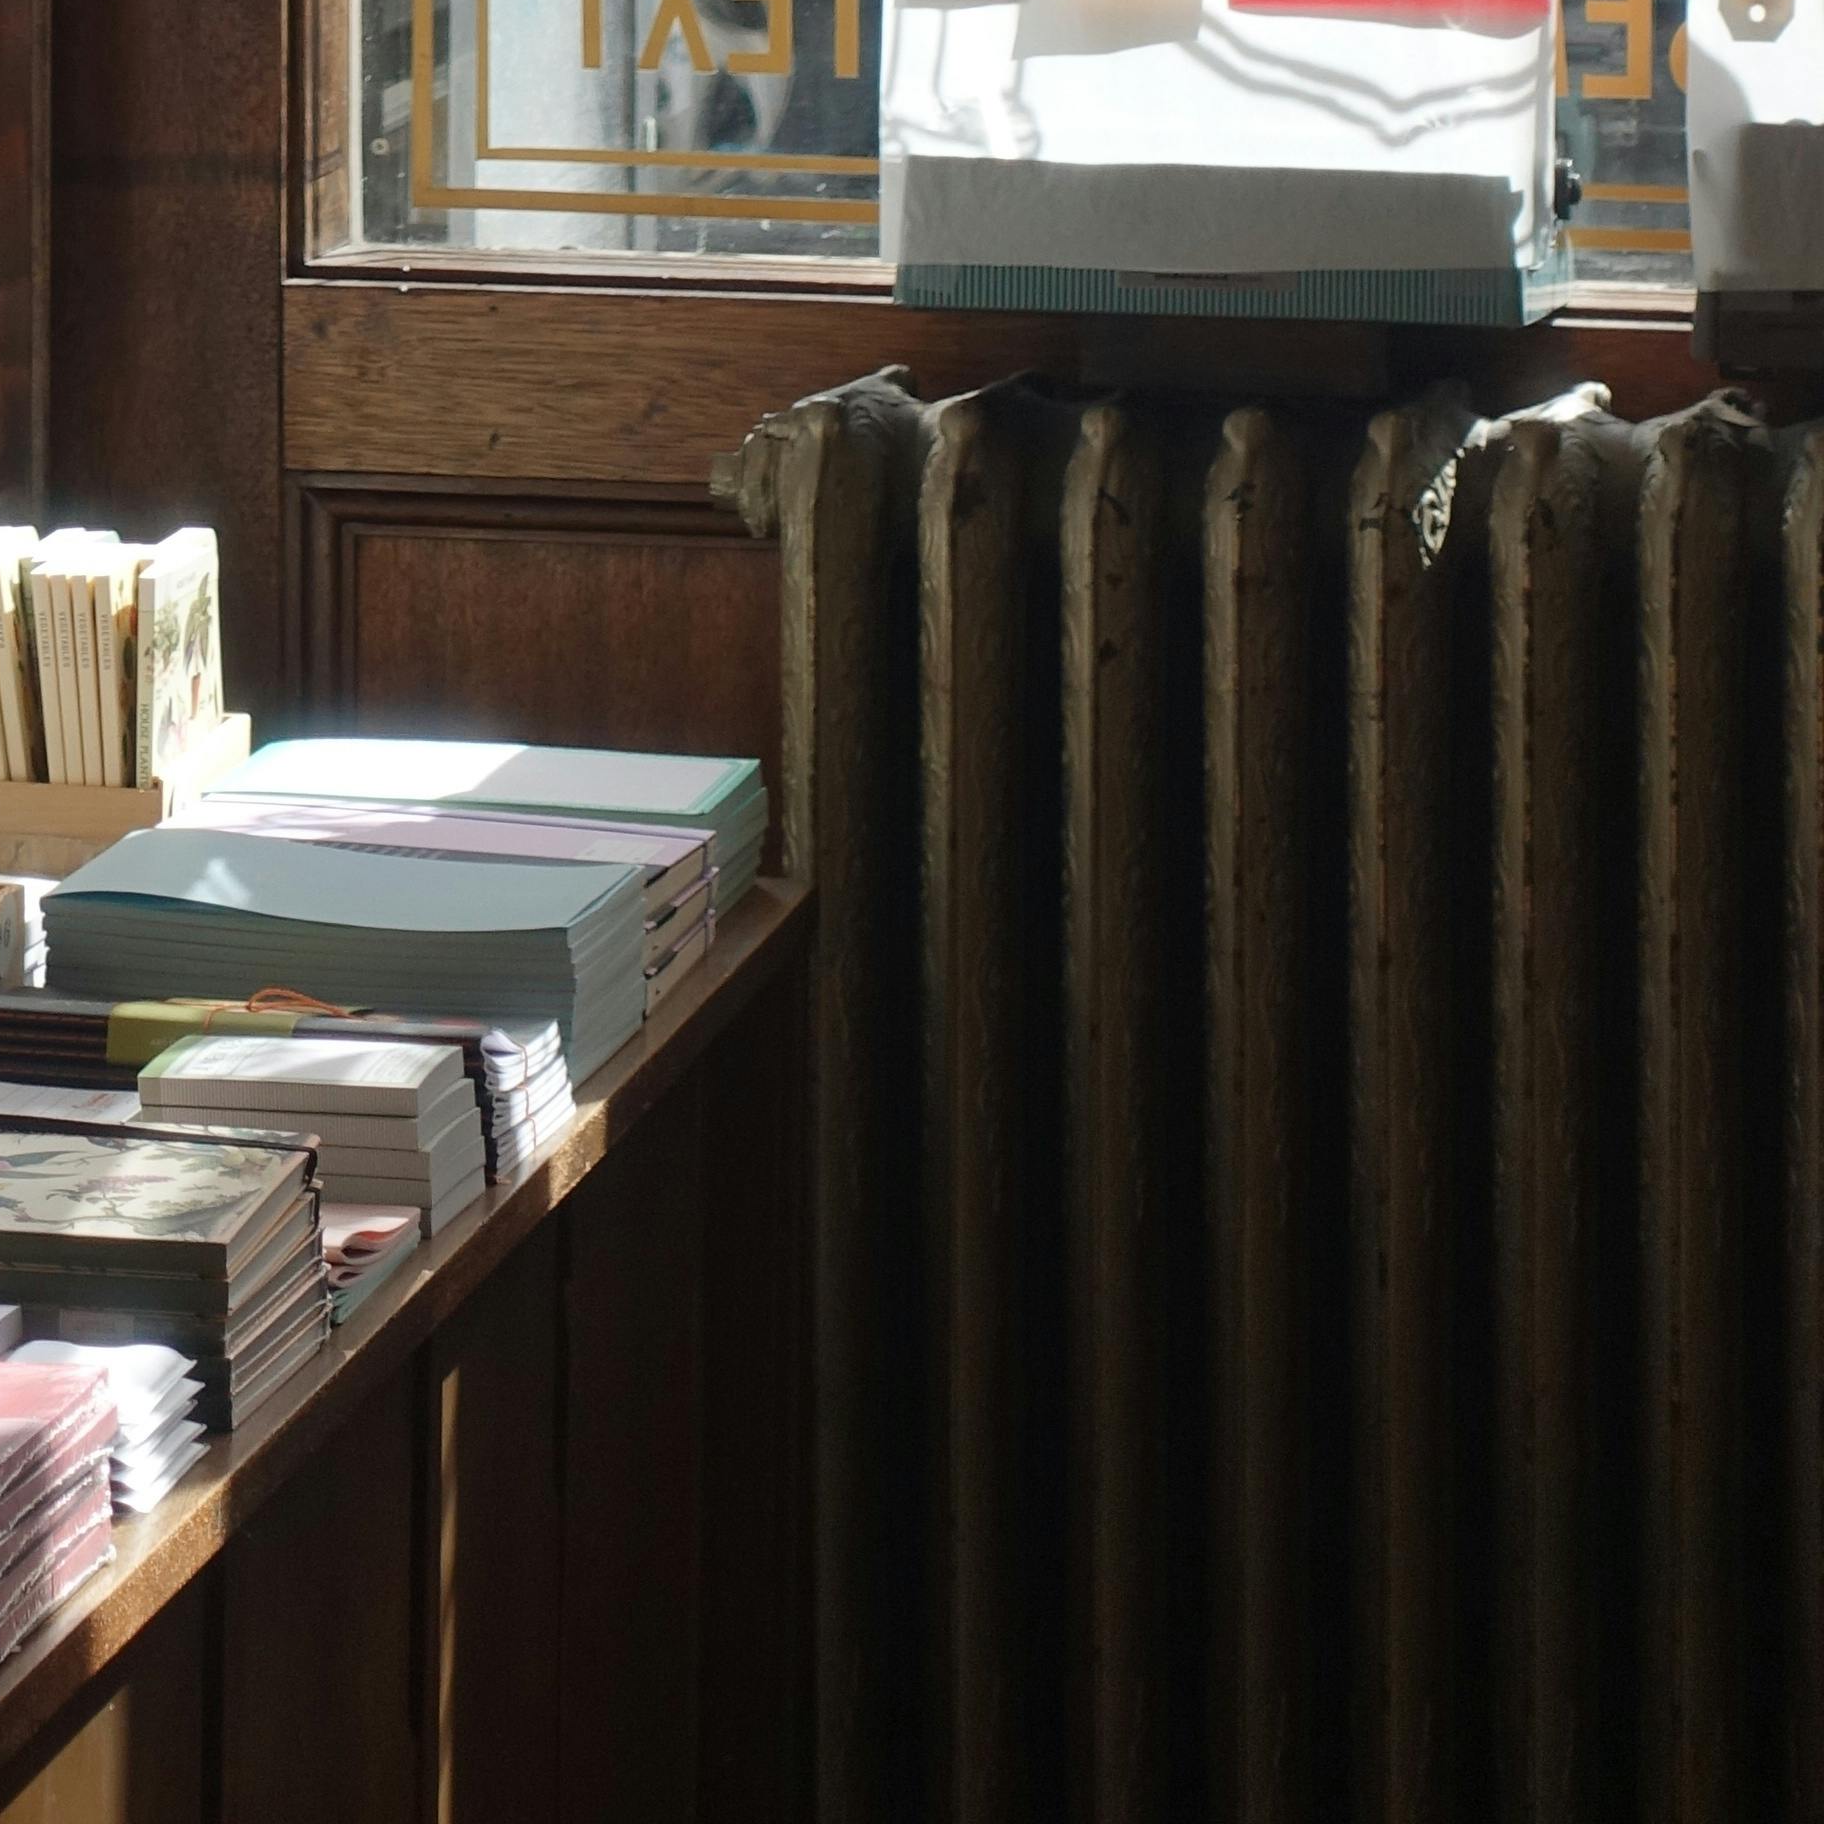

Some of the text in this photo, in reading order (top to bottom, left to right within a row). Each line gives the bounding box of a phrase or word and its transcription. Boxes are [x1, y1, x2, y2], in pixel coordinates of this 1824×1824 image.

[56, 611, 72, 670] VEGETABLES
[76, 611, 91, 670] VEGETABLES
[99, 611, 112, 672] VEGETABLES
[140, 703, 150, 738] HOUSE
